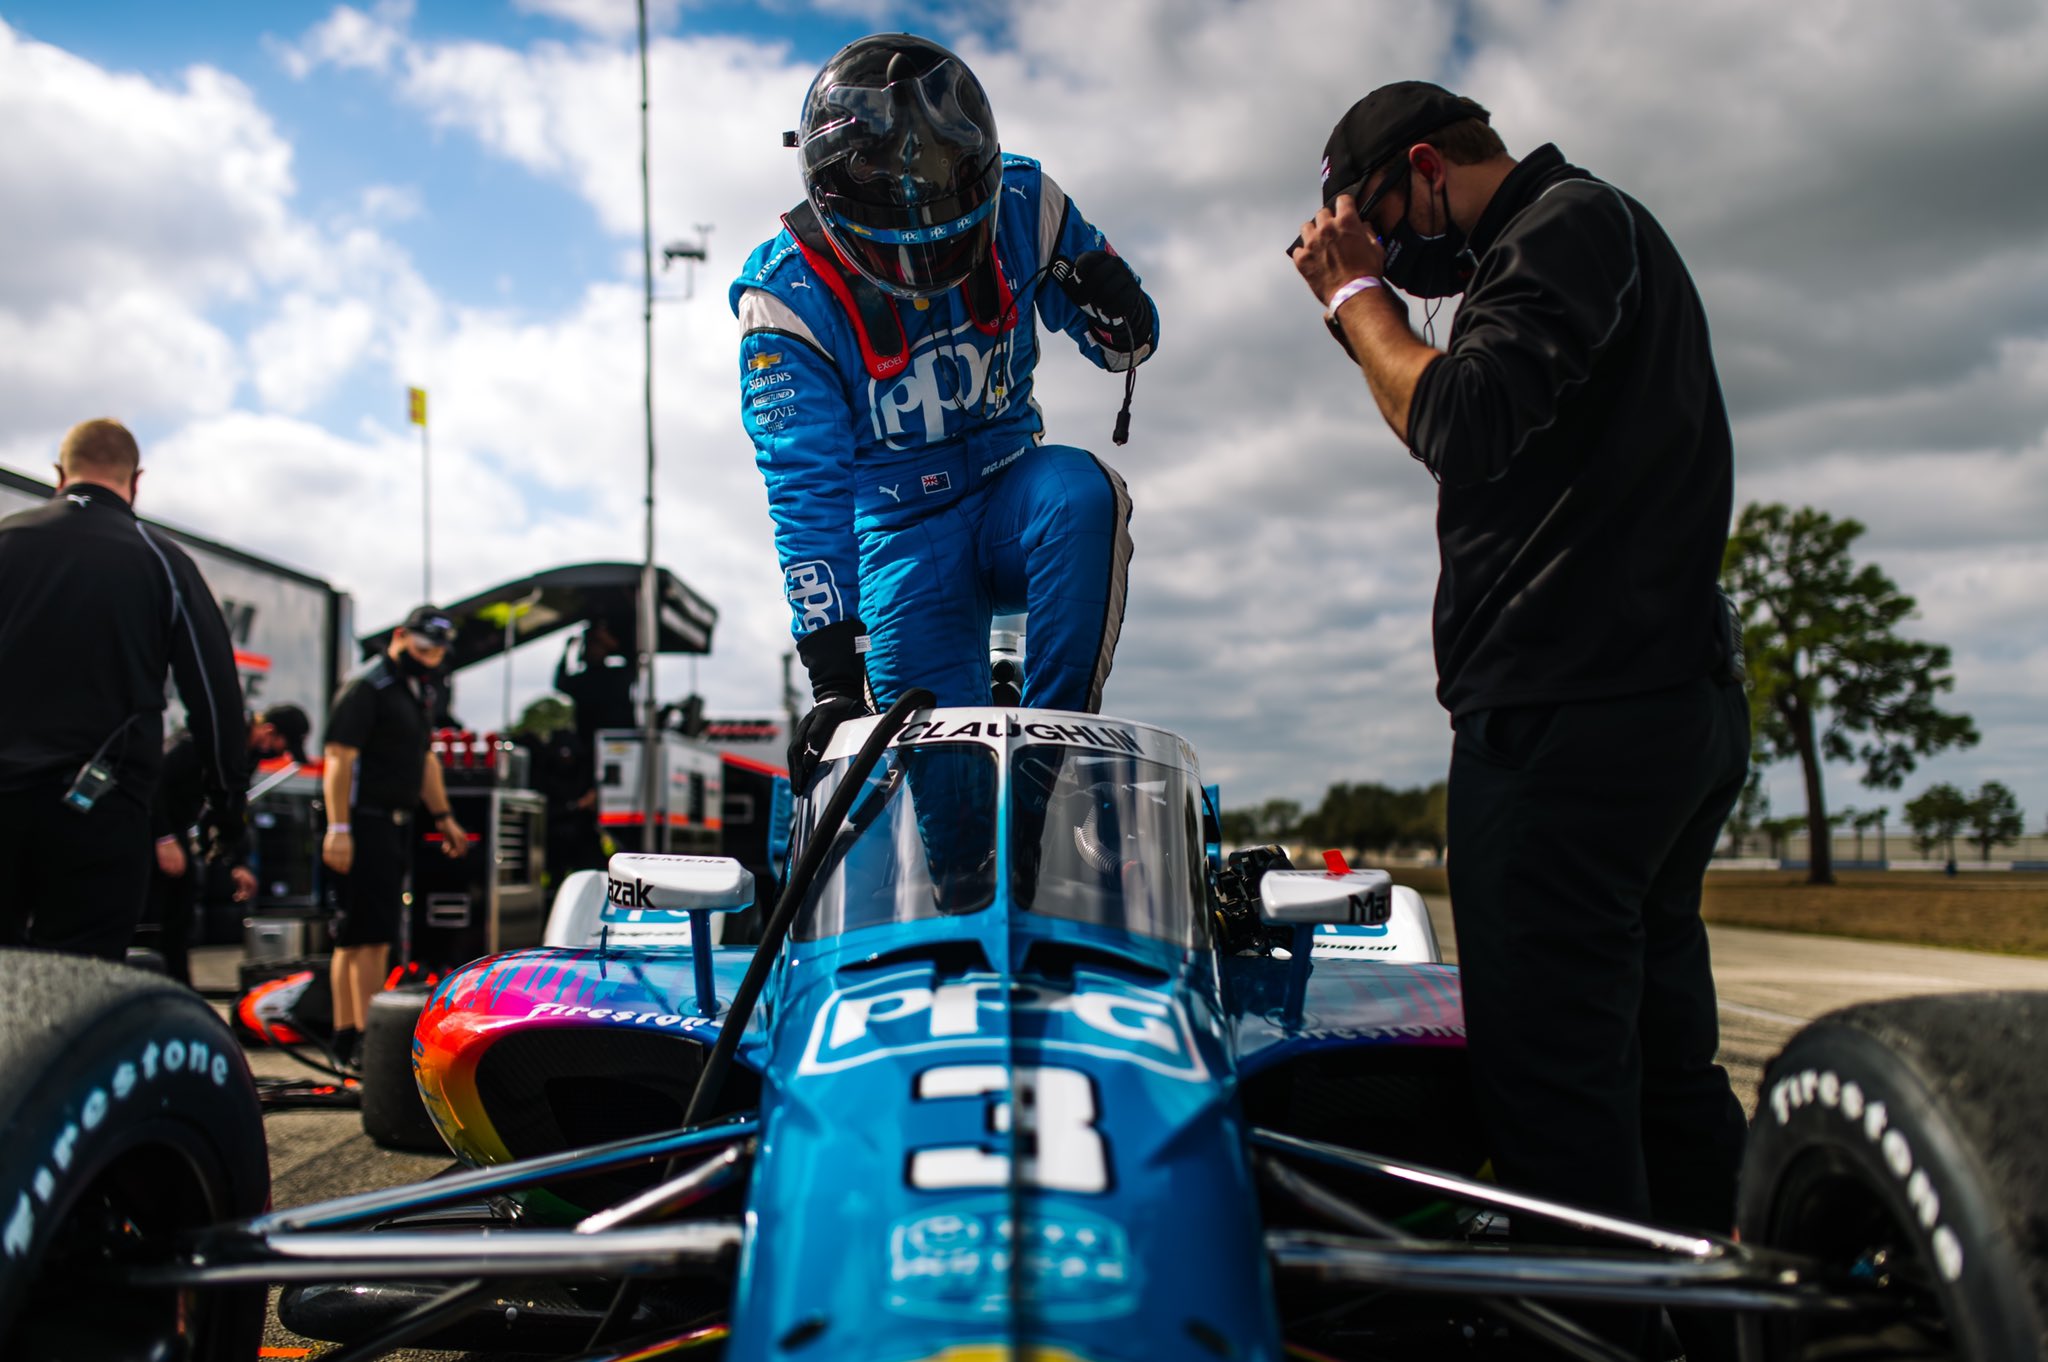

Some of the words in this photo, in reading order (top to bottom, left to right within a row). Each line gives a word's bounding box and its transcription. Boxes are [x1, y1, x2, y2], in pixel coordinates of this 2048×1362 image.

[749, 371, 792, 390] SIEMENS
[756, 404, 797, 426] GROVE
[896, 717, 1146, 756] CLAUGHLIN
[608, 878, 656, 909] azak
[907, 1063, 1114, 1195] 3
